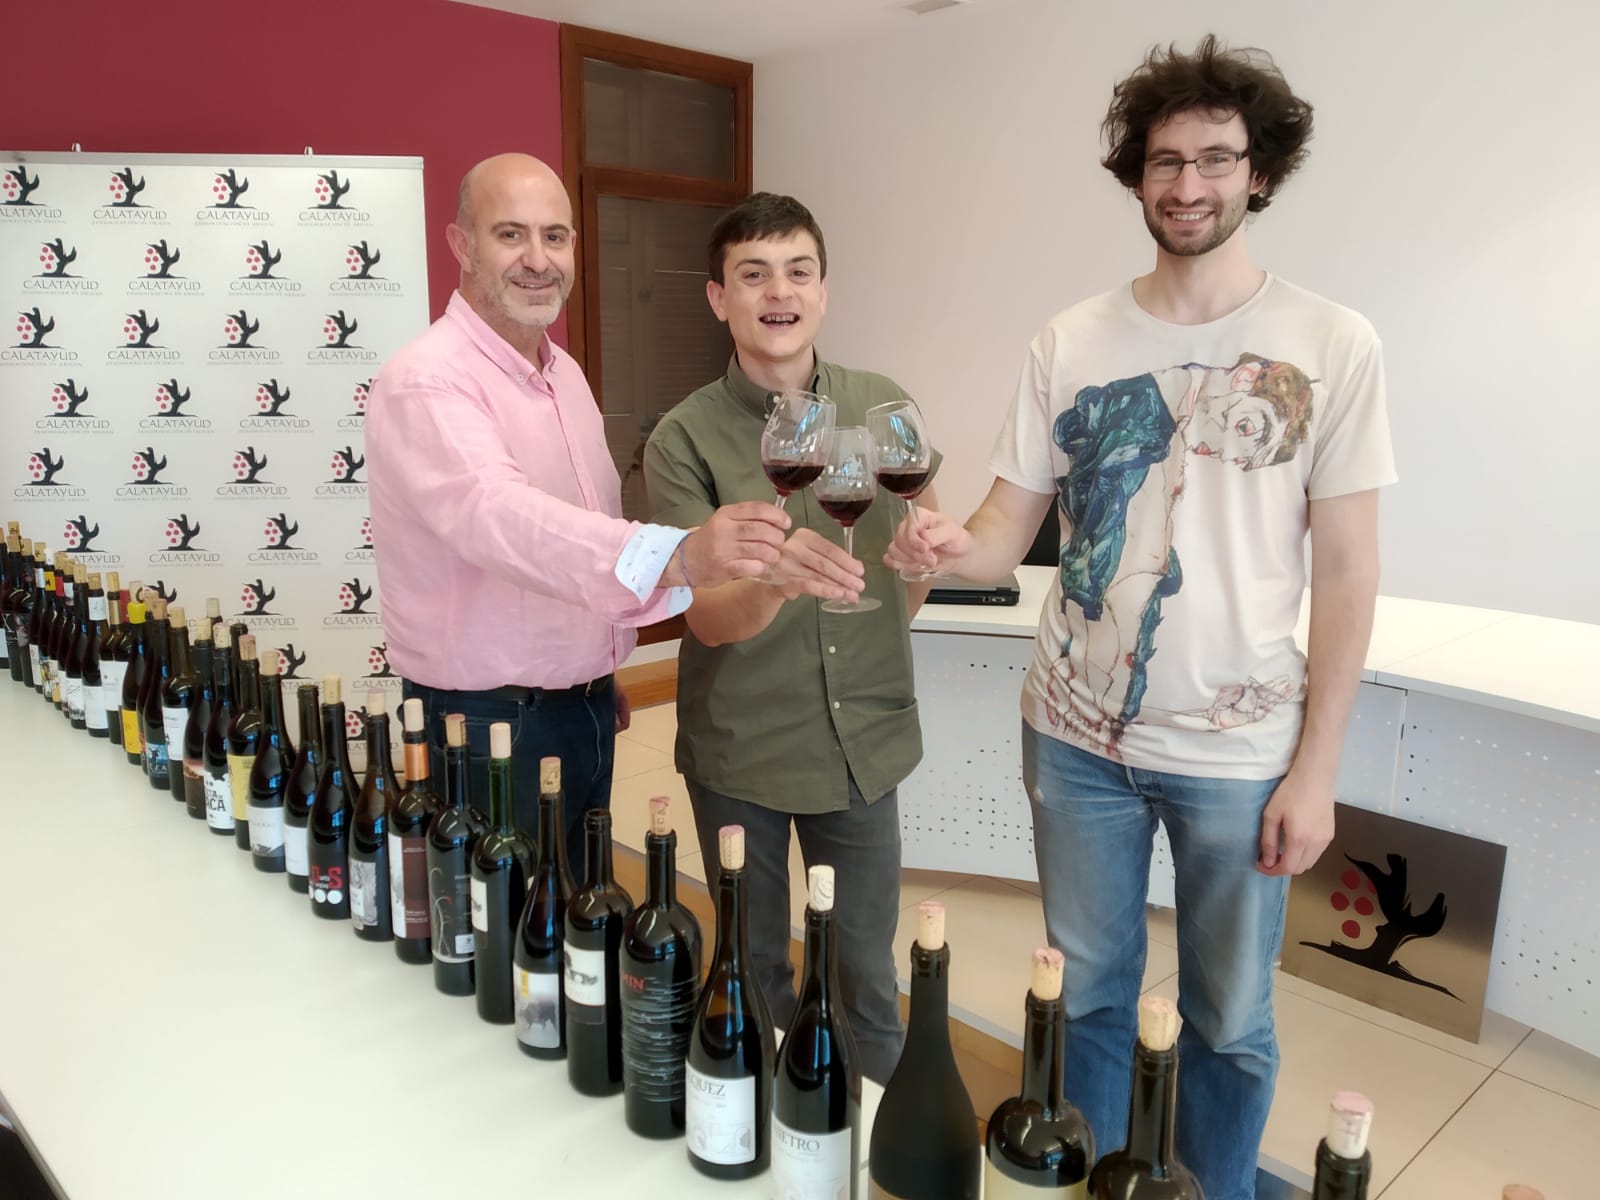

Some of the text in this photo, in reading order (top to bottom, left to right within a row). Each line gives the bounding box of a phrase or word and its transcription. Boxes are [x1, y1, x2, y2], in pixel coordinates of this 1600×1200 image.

[0, 207, 62, 218] ALATAYUD
[93, 209, 167, 220] CALATAYUD
[196, 210, 270, 221] CALATAYUD
[298, 211, 370, 221] CALATAYUD
[23, 279, 99, 290] CALATAYUD
[128, 280, 201, 290] CALATAYUD
[229, 281, 302, 292] CALATAYUD
[329, 282, 401, 292] CALATAYUD
[0, 350, 78, 361] CALATAYUD
[107, 350, 181, 360] CALATAYUD
[208, 350, 280, 361] CALATAYUD
[307, 350, 378, 361] CALATAYUD
[35, 418, 110, 429] CALATAYUD
[138, 419, 212, 429] CALATAYUD
[239, 418, 310, 428] CALATAYUD
[14, 487, 86, 497] CALATAYUD
[115, 486, 188, 496] CALATAYUD
[216, 486, 287, 496] CALATAYUD
[315, 485, 368, 495] CALATAY
[73, 553, 121, 564] ATAYUD
[149, 552, 220, 562] CALATAYUD
[247, 551, 318, 561] CALATAYUD
[322, 616, 384, 625] CALATAYU
[352, 679, 403, 689] CALATAY
